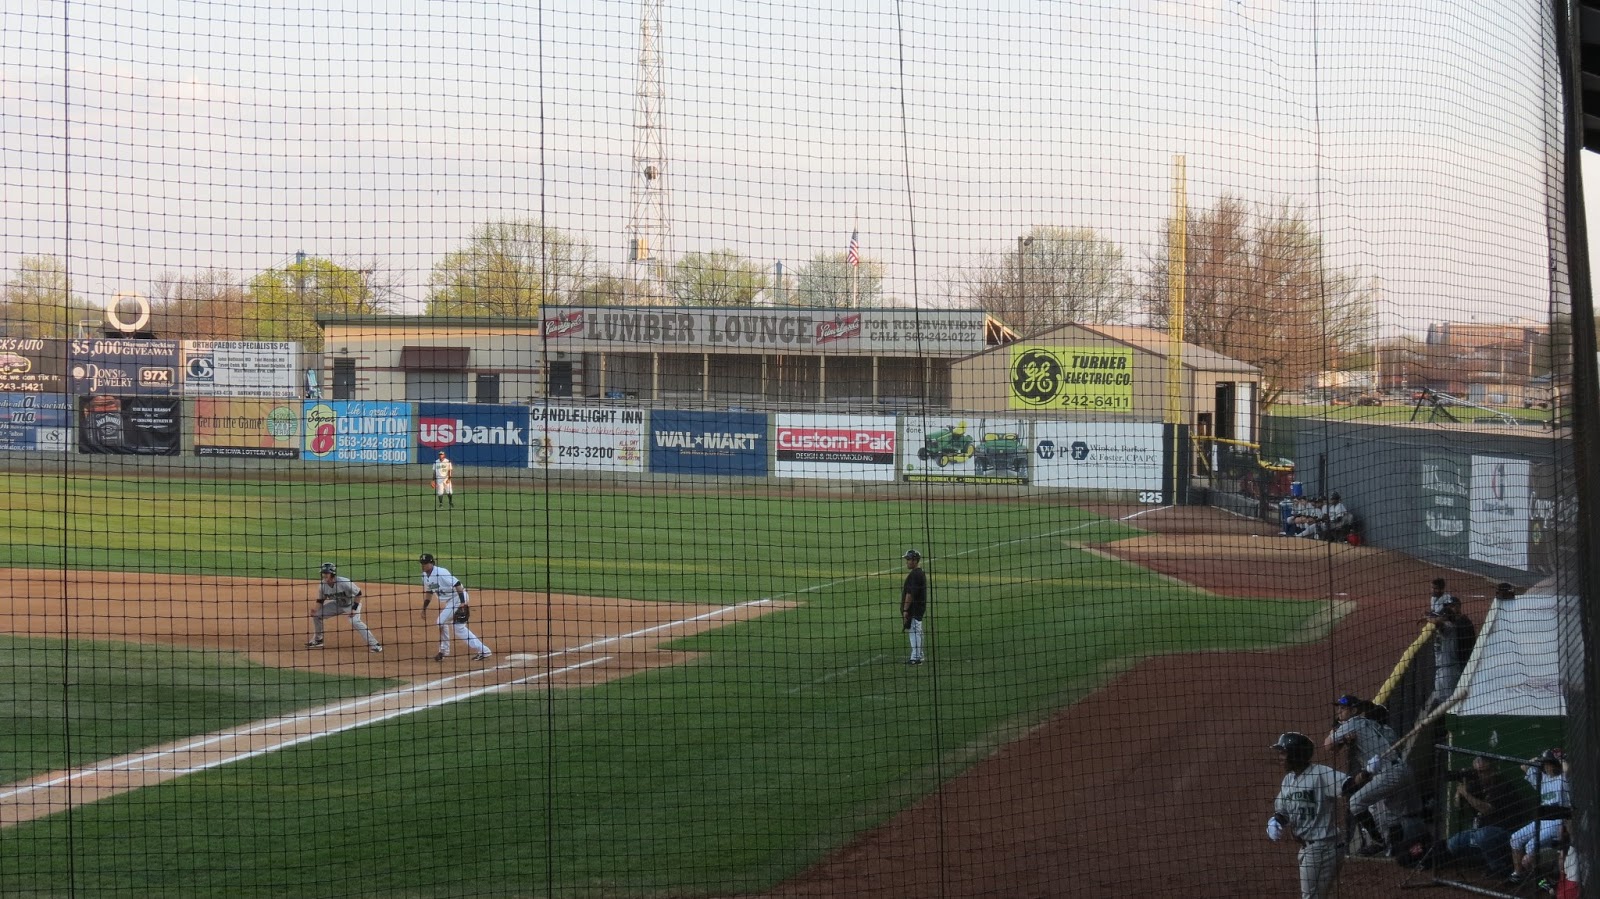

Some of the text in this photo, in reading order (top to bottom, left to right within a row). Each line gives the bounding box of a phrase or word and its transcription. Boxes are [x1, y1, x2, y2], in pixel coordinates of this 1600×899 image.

[587, 313, 812, 344] LUMBER LOUNGE
[864, 320, 984, 331] FOR RESERVATIONS
[870, 332, 977, 342] CALL 563-242-0727
[17, 339, 44, 350] AUTO
[72, 340, 121, 357] $5,000
[192, 341, 237, 349] ORTHOPAEDIC
[238, 342, 278, 350] SPECIALISTS
[122, 347, 175, 356] GIVEAWAY
[1071, 355, 1127, 370] TURNER
[143, 370, 168, 381] 97X
[1064, 372, 1132, 386] ELECTRIC CO.
[89, 377, 133, 392] JEWELRY
[1061, 395, 1129, 408] 242-6411
[307, 411, 336, 428] Super
[532, 407, 643, 424] CANDLELIGHT INN
[198, 415, 210, 428] Get
[224, 416, 236, 429] the
[238, 416, 265, 430] Game!
[338, 416, 408, 436] CLINTON
[311, 423, 336, 454] 8
[338, 435, 407, 449] 563-242-8870
[778, 431, 893, 451] Custom-Pak
[338, 449, 407, 462] 800-800-8000
[559, 446, 613, 459] 243-3200
[795, 452, 818, 460] DESIGN
[1099, 454, 1124, 462] Foster,
[1126, 454, 1143, 462] CPA
[1145, 455, 1158, 463] PC
[1139, 491, 1163, 503] 325
